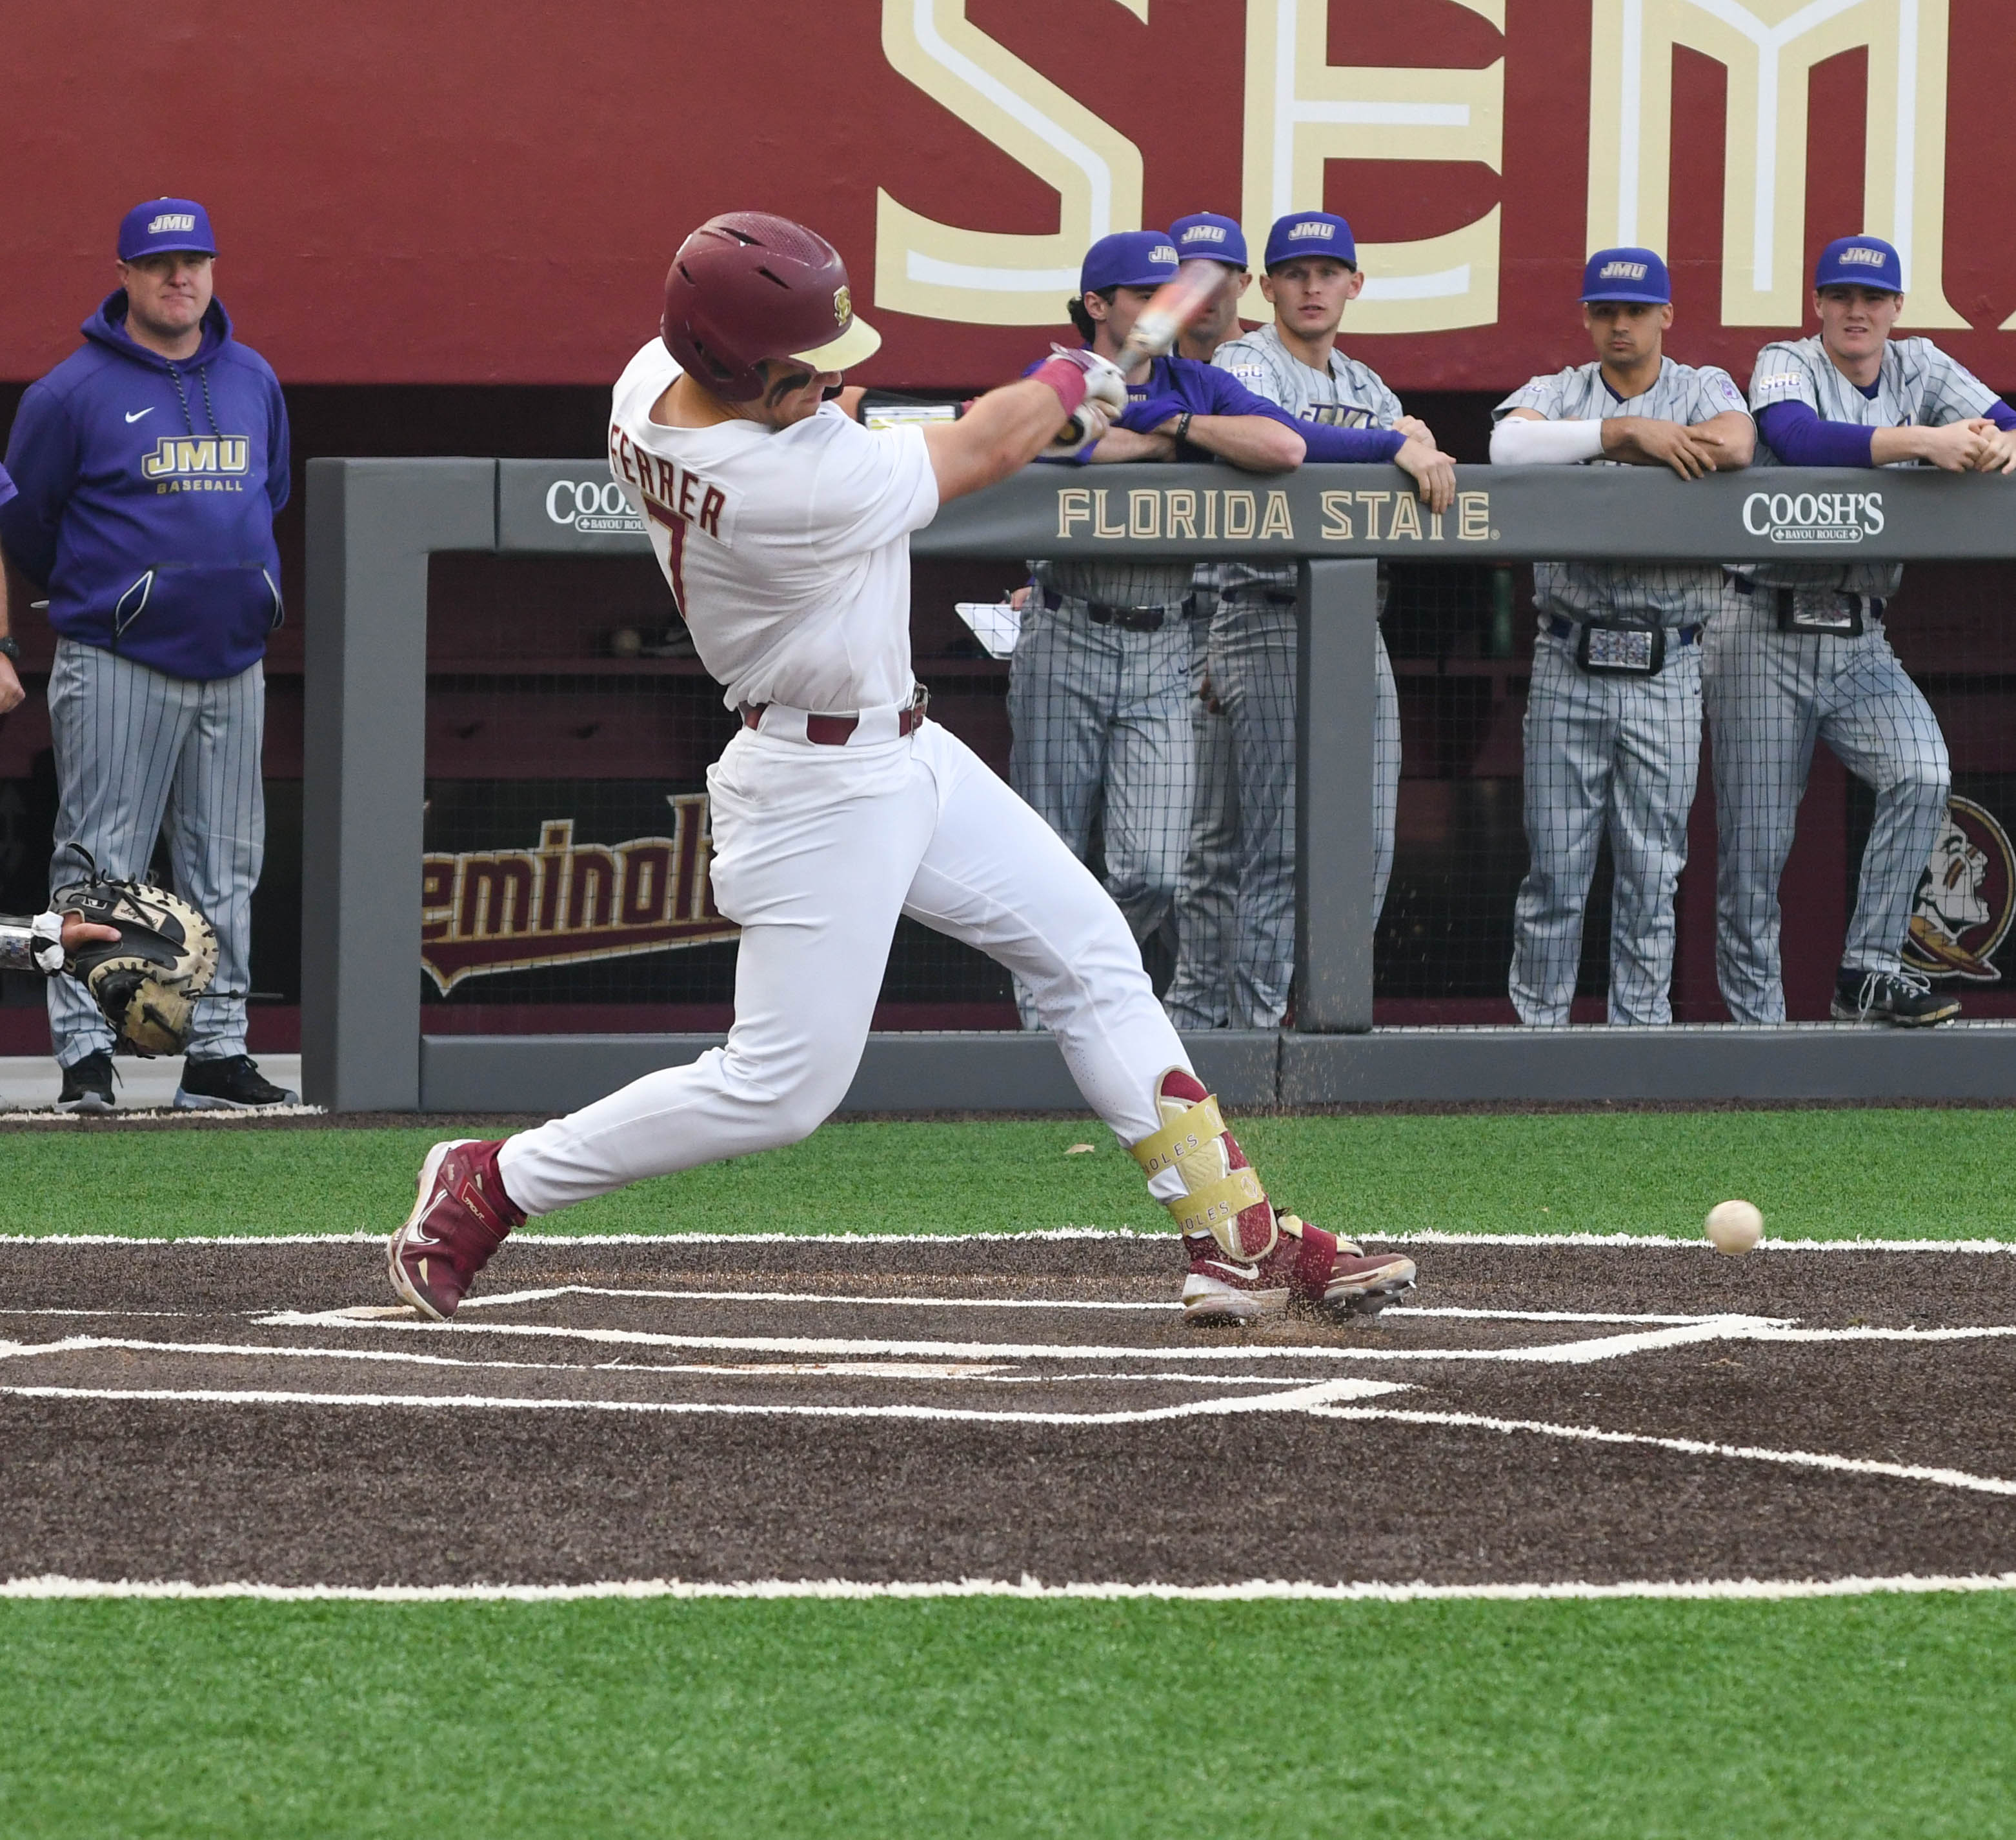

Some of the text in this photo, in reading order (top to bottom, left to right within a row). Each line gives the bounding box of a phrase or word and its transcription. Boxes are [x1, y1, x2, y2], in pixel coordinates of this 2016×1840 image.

[874, 0, 2016, 334] SEM
[148, 213, 196, 234] JMU
[1288, 222, 1335, 241] JMU
[1180, 225, 1227, 244] JMU
[1839, 247, 1886, 268] JMU
[1600, 261, 1648, 280] JMU
[142, 435, 250, 480] JMU
[157, 480, 243, 494] BASEBALL
[610, 423, 726, 539] FERRER
[590, 519, 623, 529] BAYOU
[1056, 488, 1295, 539] FLORIDA
[1785, 530, 1849, 539] BAYOU ROUGE
[641, 493, 689, 621] 7
